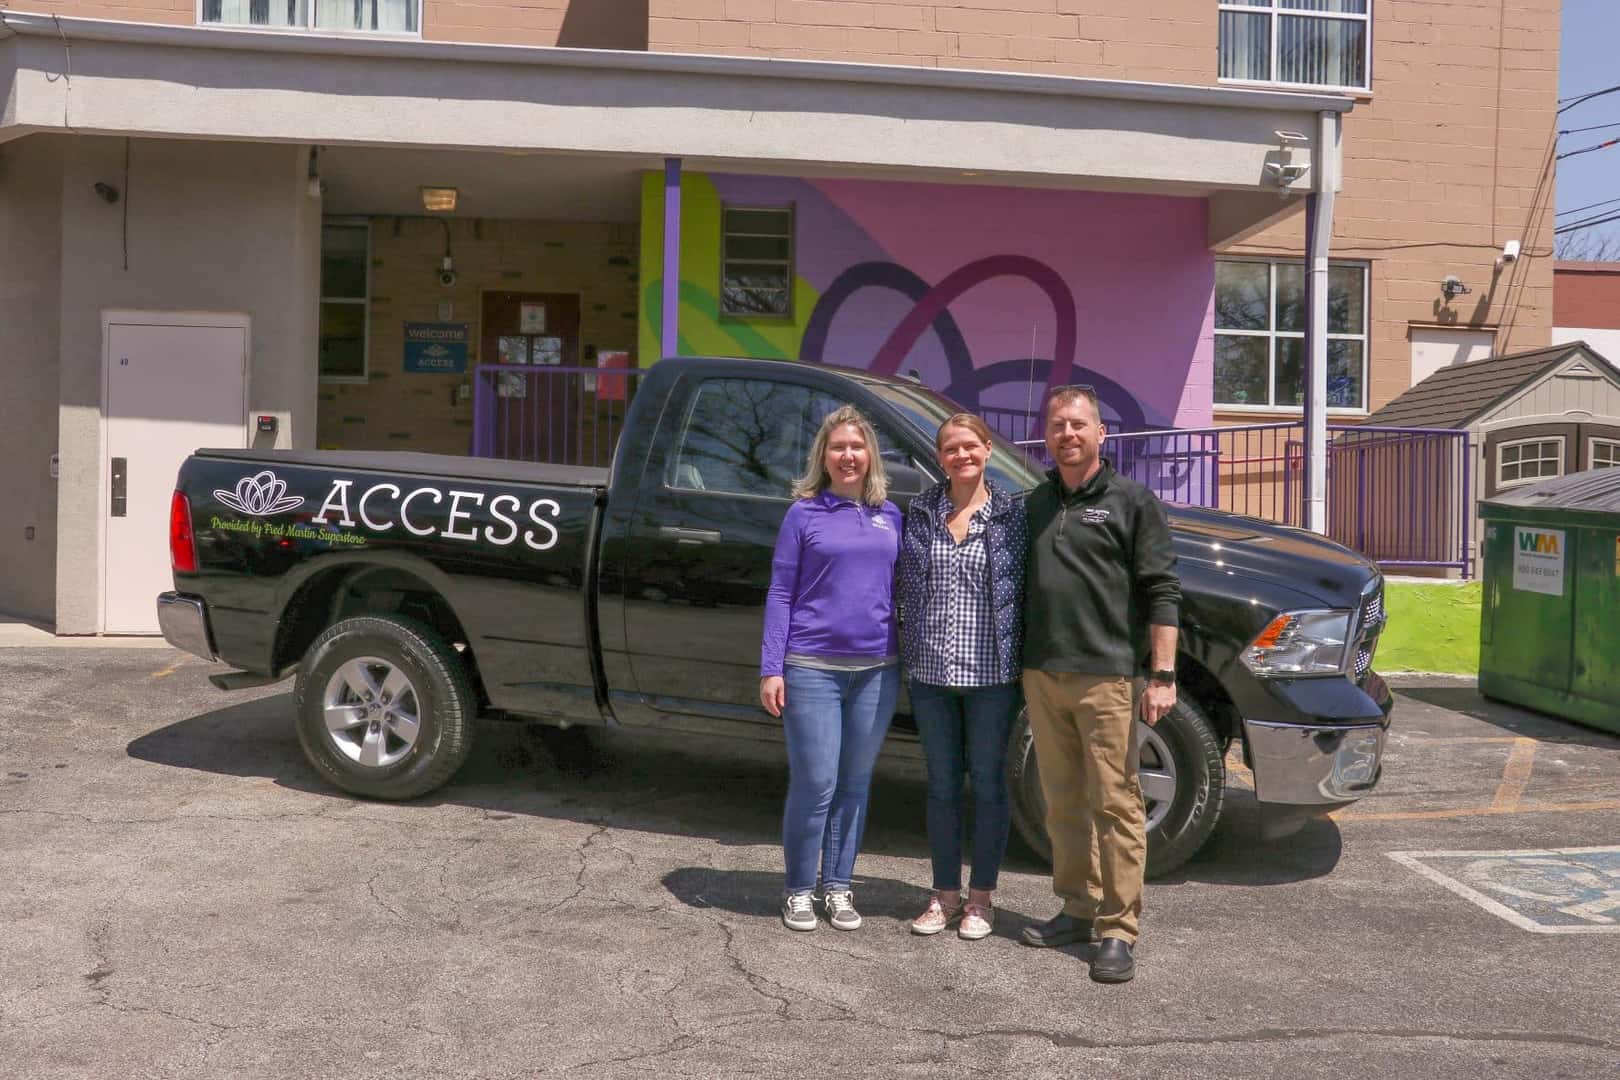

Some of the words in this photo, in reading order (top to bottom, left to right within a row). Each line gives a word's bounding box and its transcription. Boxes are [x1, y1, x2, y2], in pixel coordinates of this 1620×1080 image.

[408, 327, 464, 339] welcome
[311, 479, 561, 550] ACCESS
[211, 516, 250, 532] Provided
[251, 520, 262, 538] by
[263, 522, 285, 537] Fred
[285, 524, 317, 540] Martin
[317, 528, 367, 546] Superstore
[1519, 531, 1558, 554] WM
